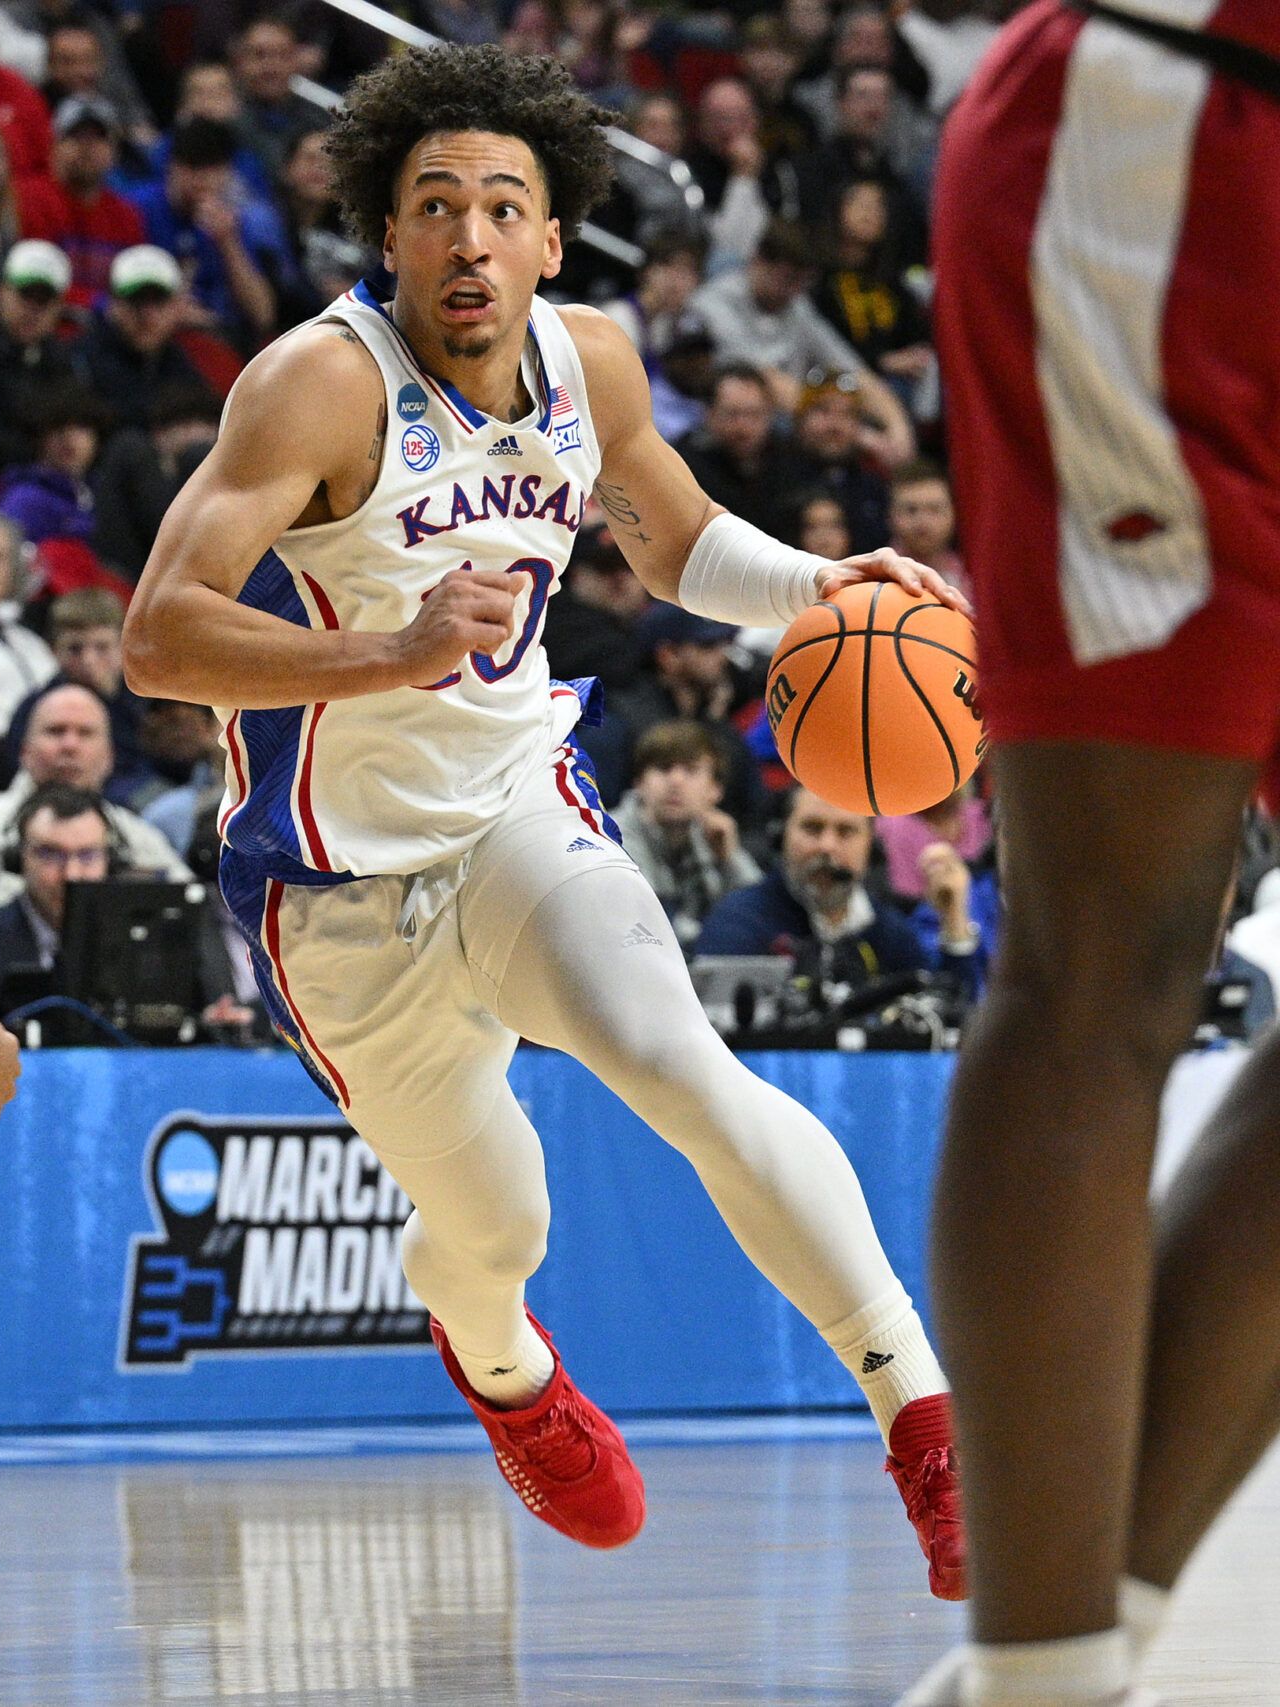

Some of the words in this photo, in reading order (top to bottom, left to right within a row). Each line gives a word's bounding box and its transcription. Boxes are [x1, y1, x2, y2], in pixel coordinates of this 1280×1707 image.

[401, 402, 426, 413] NCAA
[405, 441, 424, 456] 125
[487, 446, 523, 457] adidas
[411, 557, 554, 690] 0
[566, 843, 605, 853] adidas
[238, 1226, 426, 1316] MADN
[862, 1352, 894, 1374] adidas
